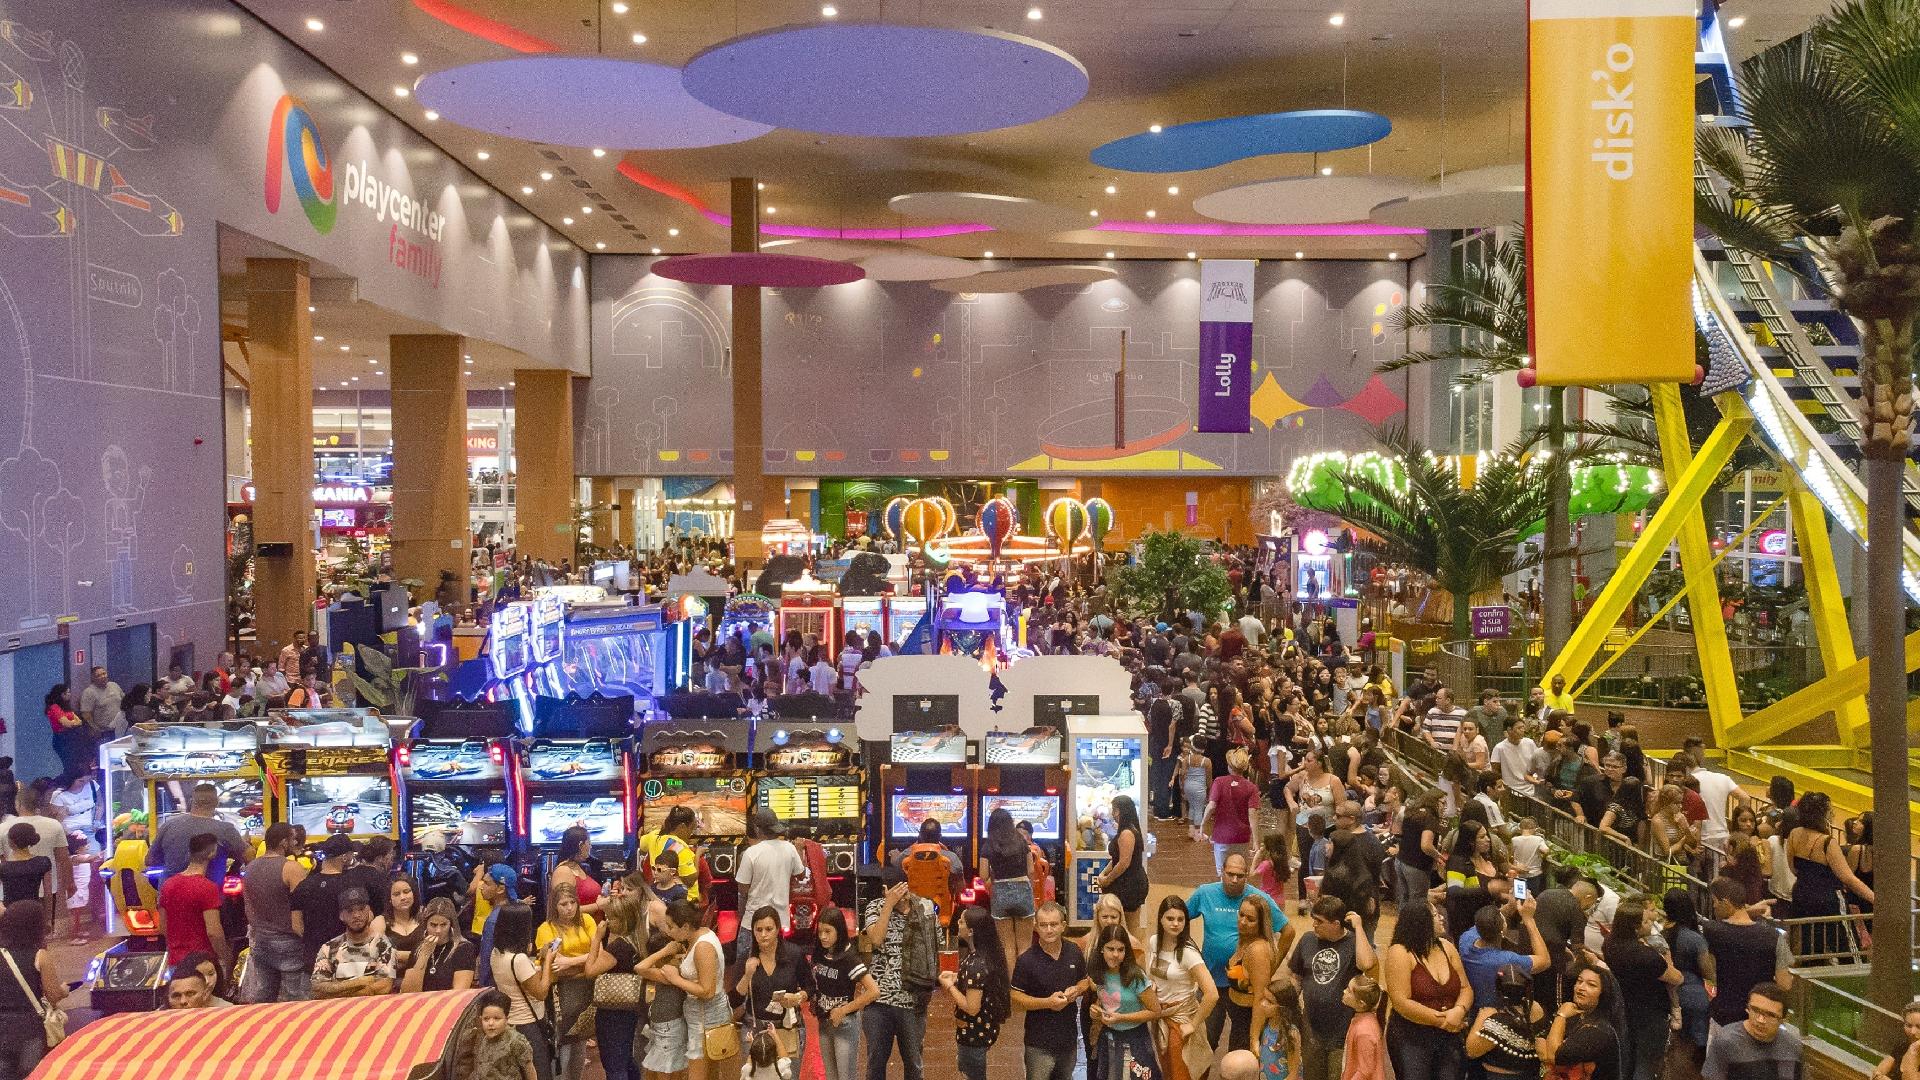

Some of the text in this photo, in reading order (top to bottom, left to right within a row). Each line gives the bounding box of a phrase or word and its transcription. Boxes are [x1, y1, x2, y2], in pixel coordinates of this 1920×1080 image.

[1591, 42, 1635, 181] disk'o
[343, 159, 447, 243] playcenter
[388, 223, 442, 290] family
[1214, 353, 1237, 397] Lolly
[466, 437, 497, 449] KING
[1479, 609, 1503, 618] confira
[1096, 741, 1124, 749] PRIZE
